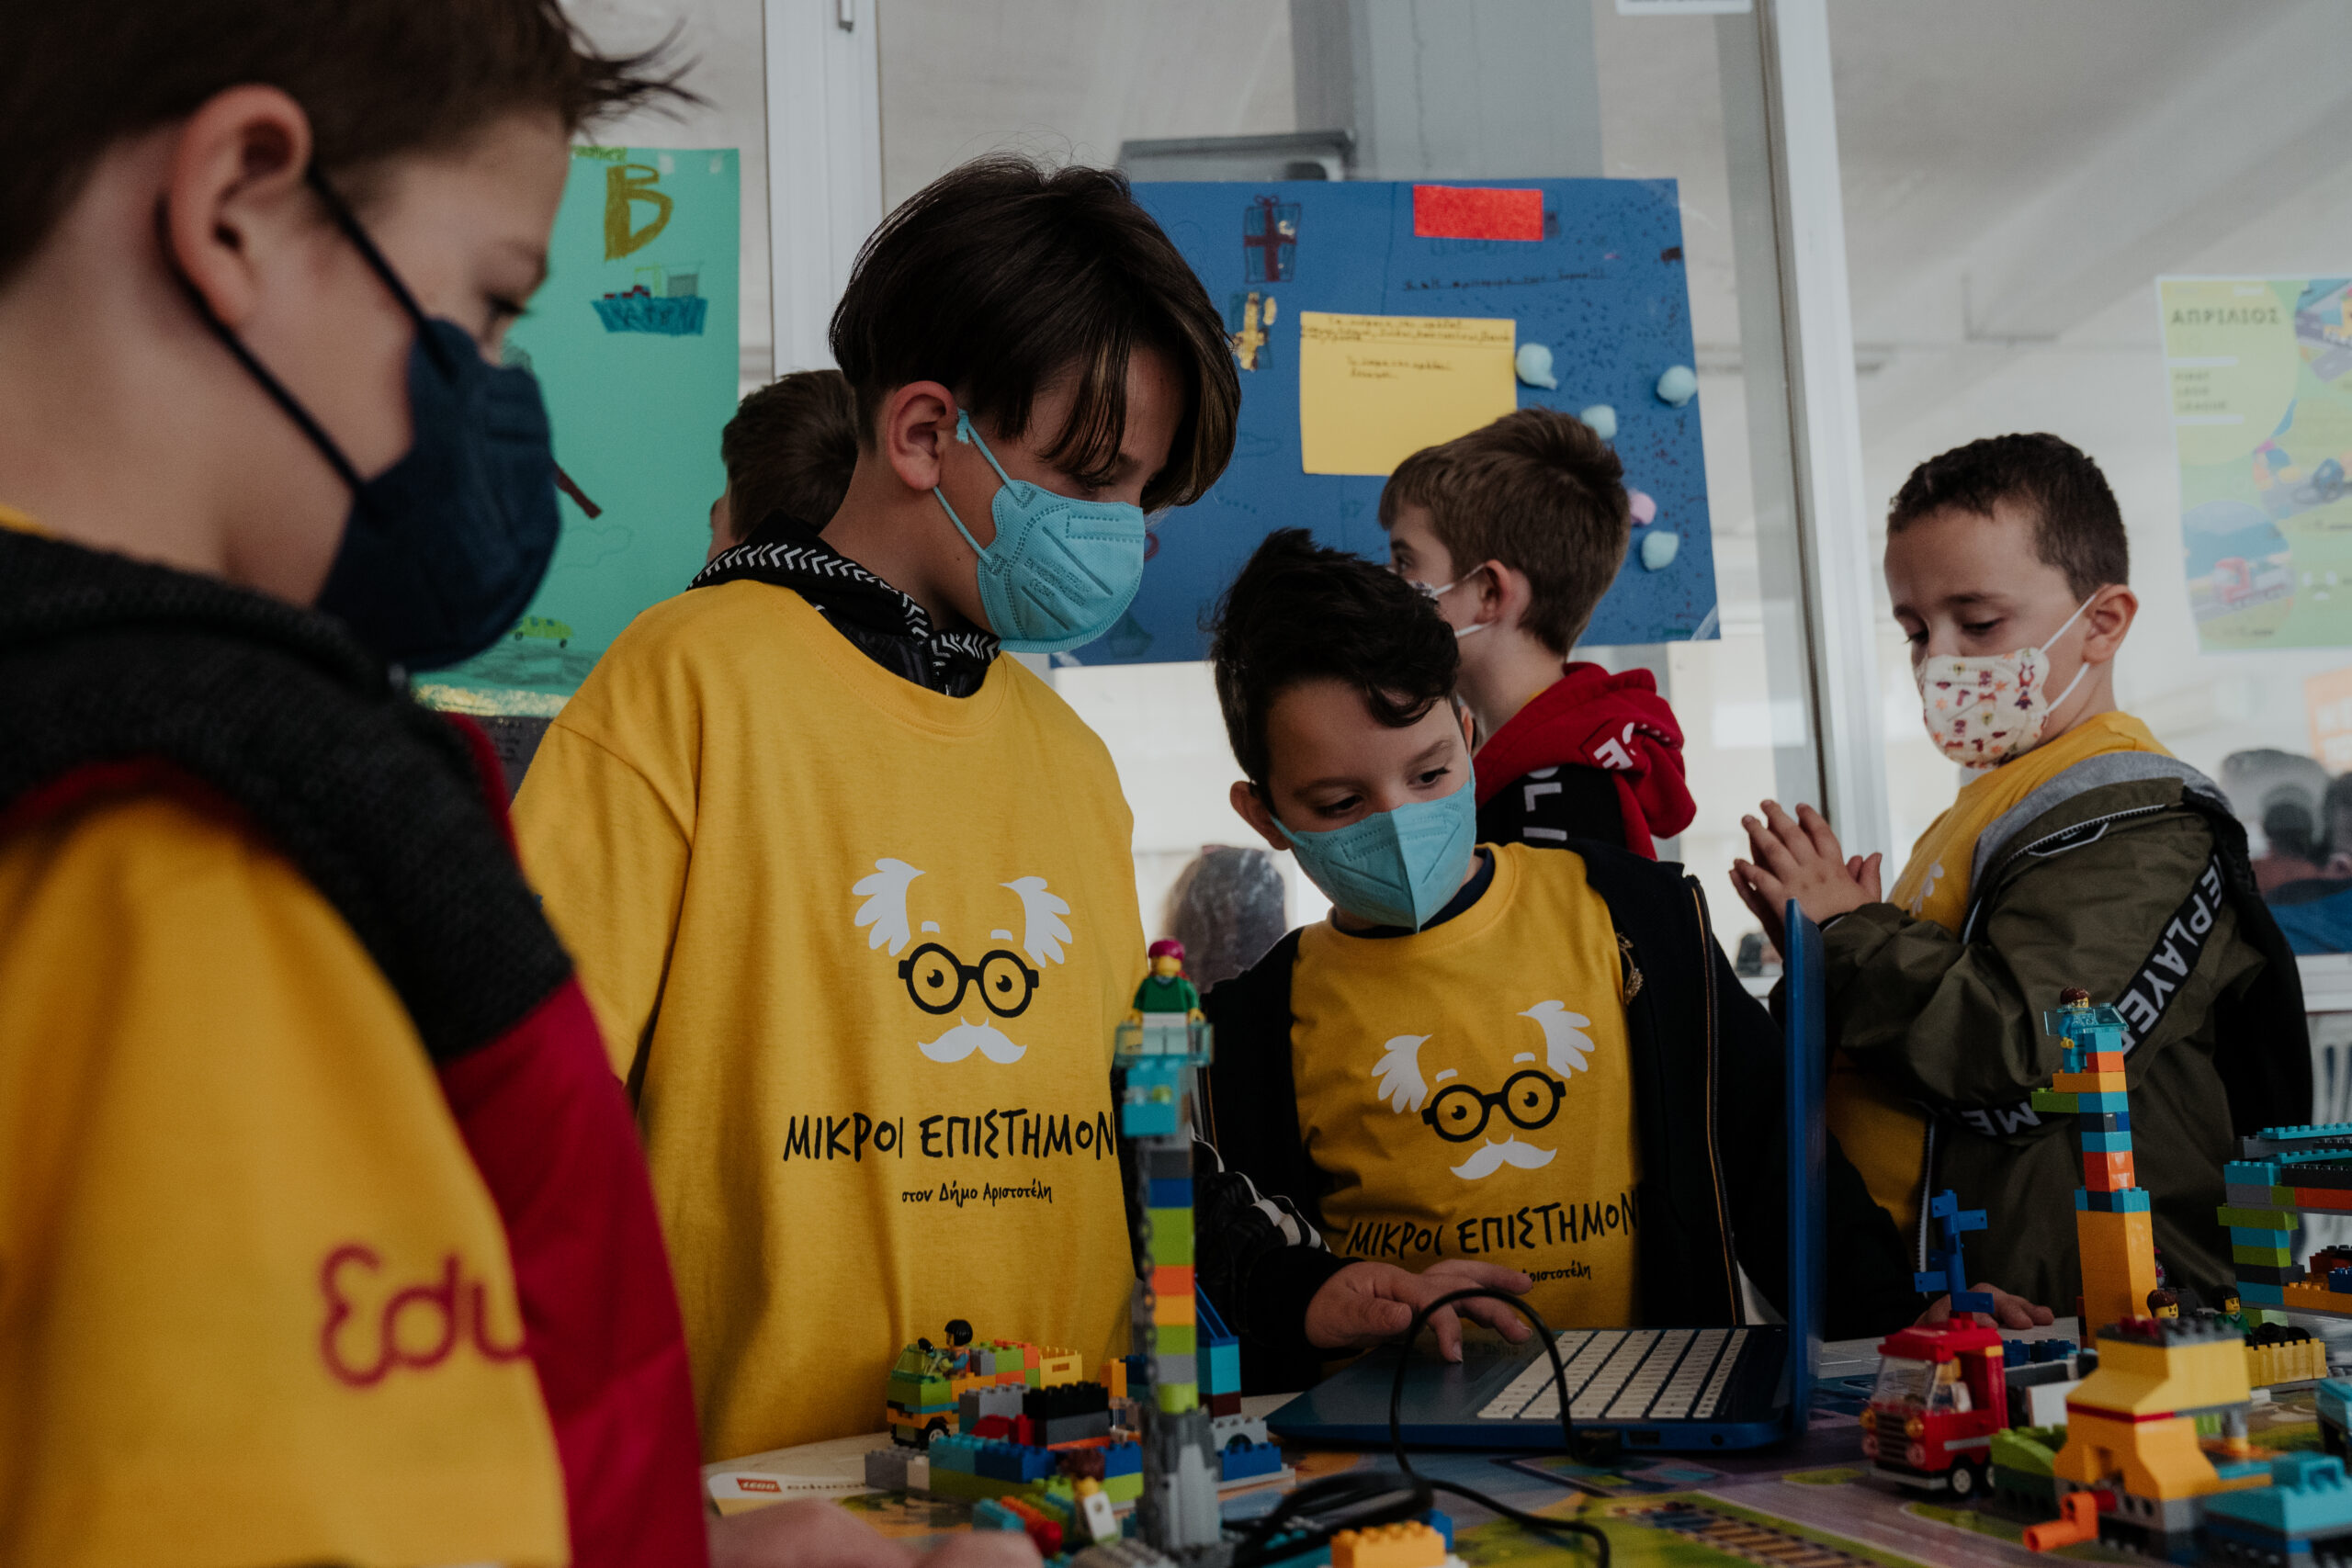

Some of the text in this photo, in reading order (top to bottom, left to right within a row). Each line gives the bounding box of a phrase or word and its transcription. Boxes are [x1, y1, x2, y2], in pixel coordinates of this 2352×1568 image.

[2170, 306, 2280, 325] ΑΠΡΙΛΙΟΣ
[2119, 853, 2224, 1056] EPLAYE
[784, 1111, 903, 1162] ΜΙΚΡΟΙ
[901, 1178, 1053, 1208] στον Δήμο Αριστοτέλη
[1345, 1221, 1443, 1259] ΜΙΚΡΟΙ
[1521, 1259, 1592, 1282] ριστοτέλη
